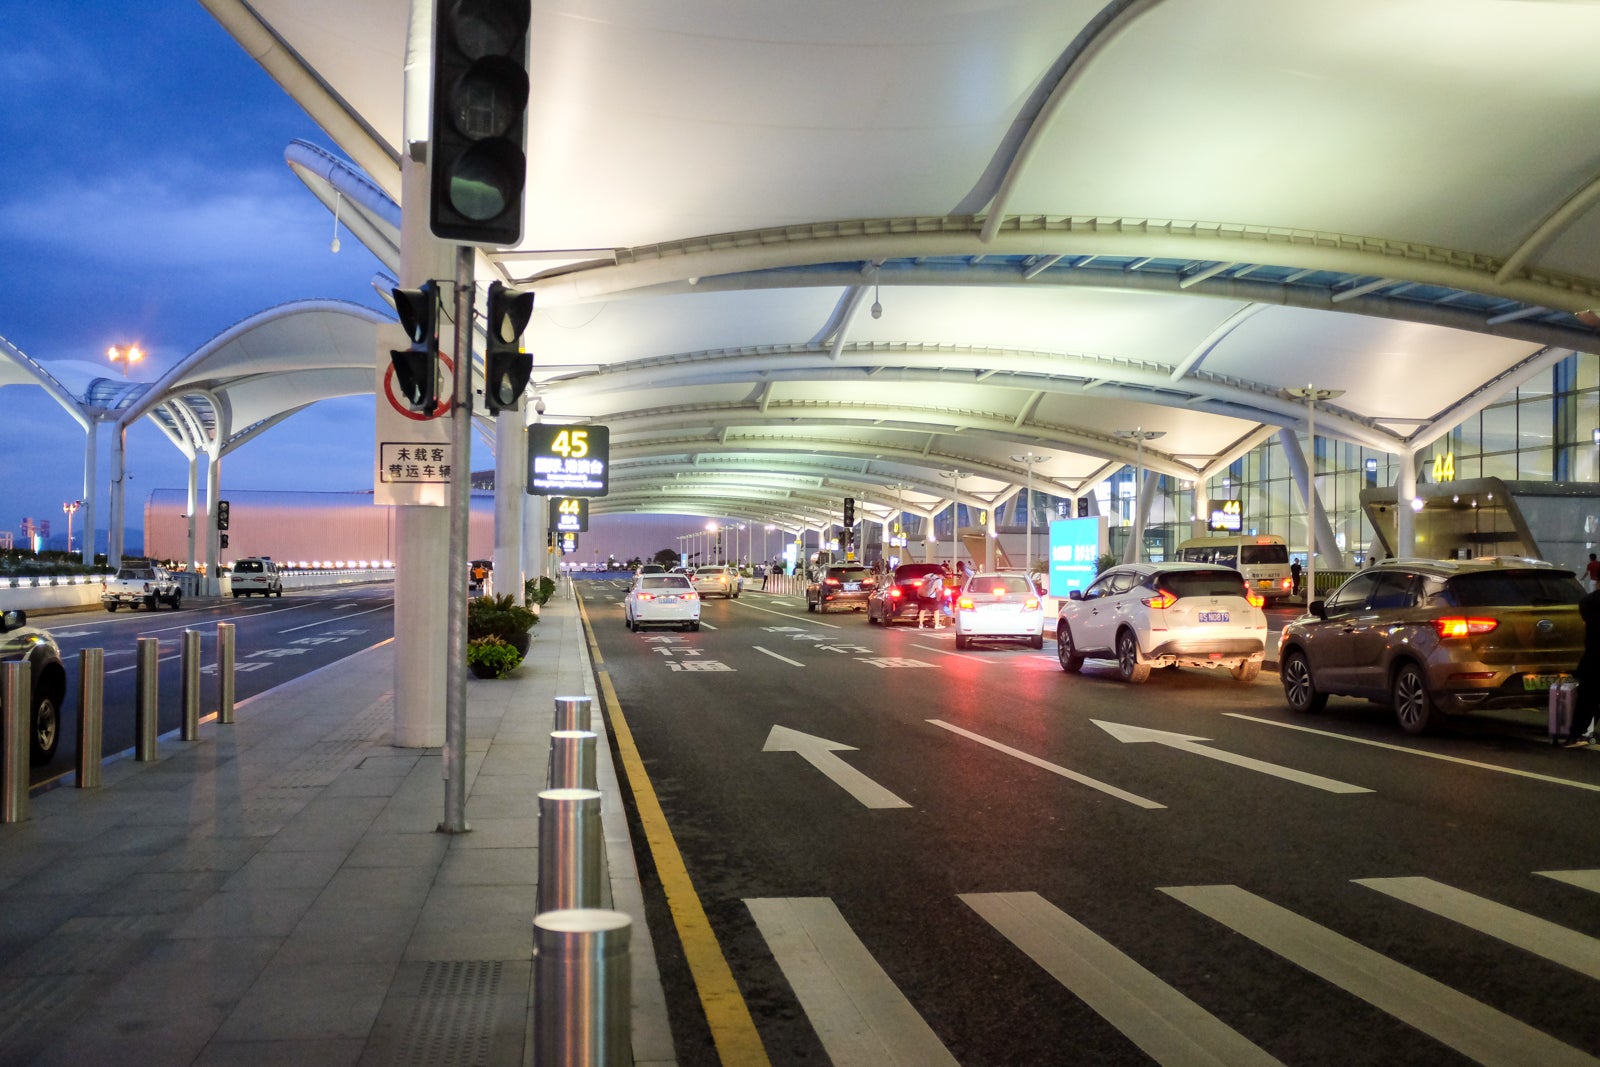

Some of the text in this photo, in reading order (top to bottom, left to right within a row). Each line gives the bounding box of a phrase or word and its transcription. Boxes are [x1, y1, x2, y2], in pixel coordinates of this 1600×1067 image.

[552, 430, 588, 458] 45
[397, 448, 444, 461] 未载客
[389, 464, 451, 478] 营运车辆
[1432, 452, 1455, 483] 44
[559, 500, 580, 515] 44
[1223, 501, 1241, 515] 44
